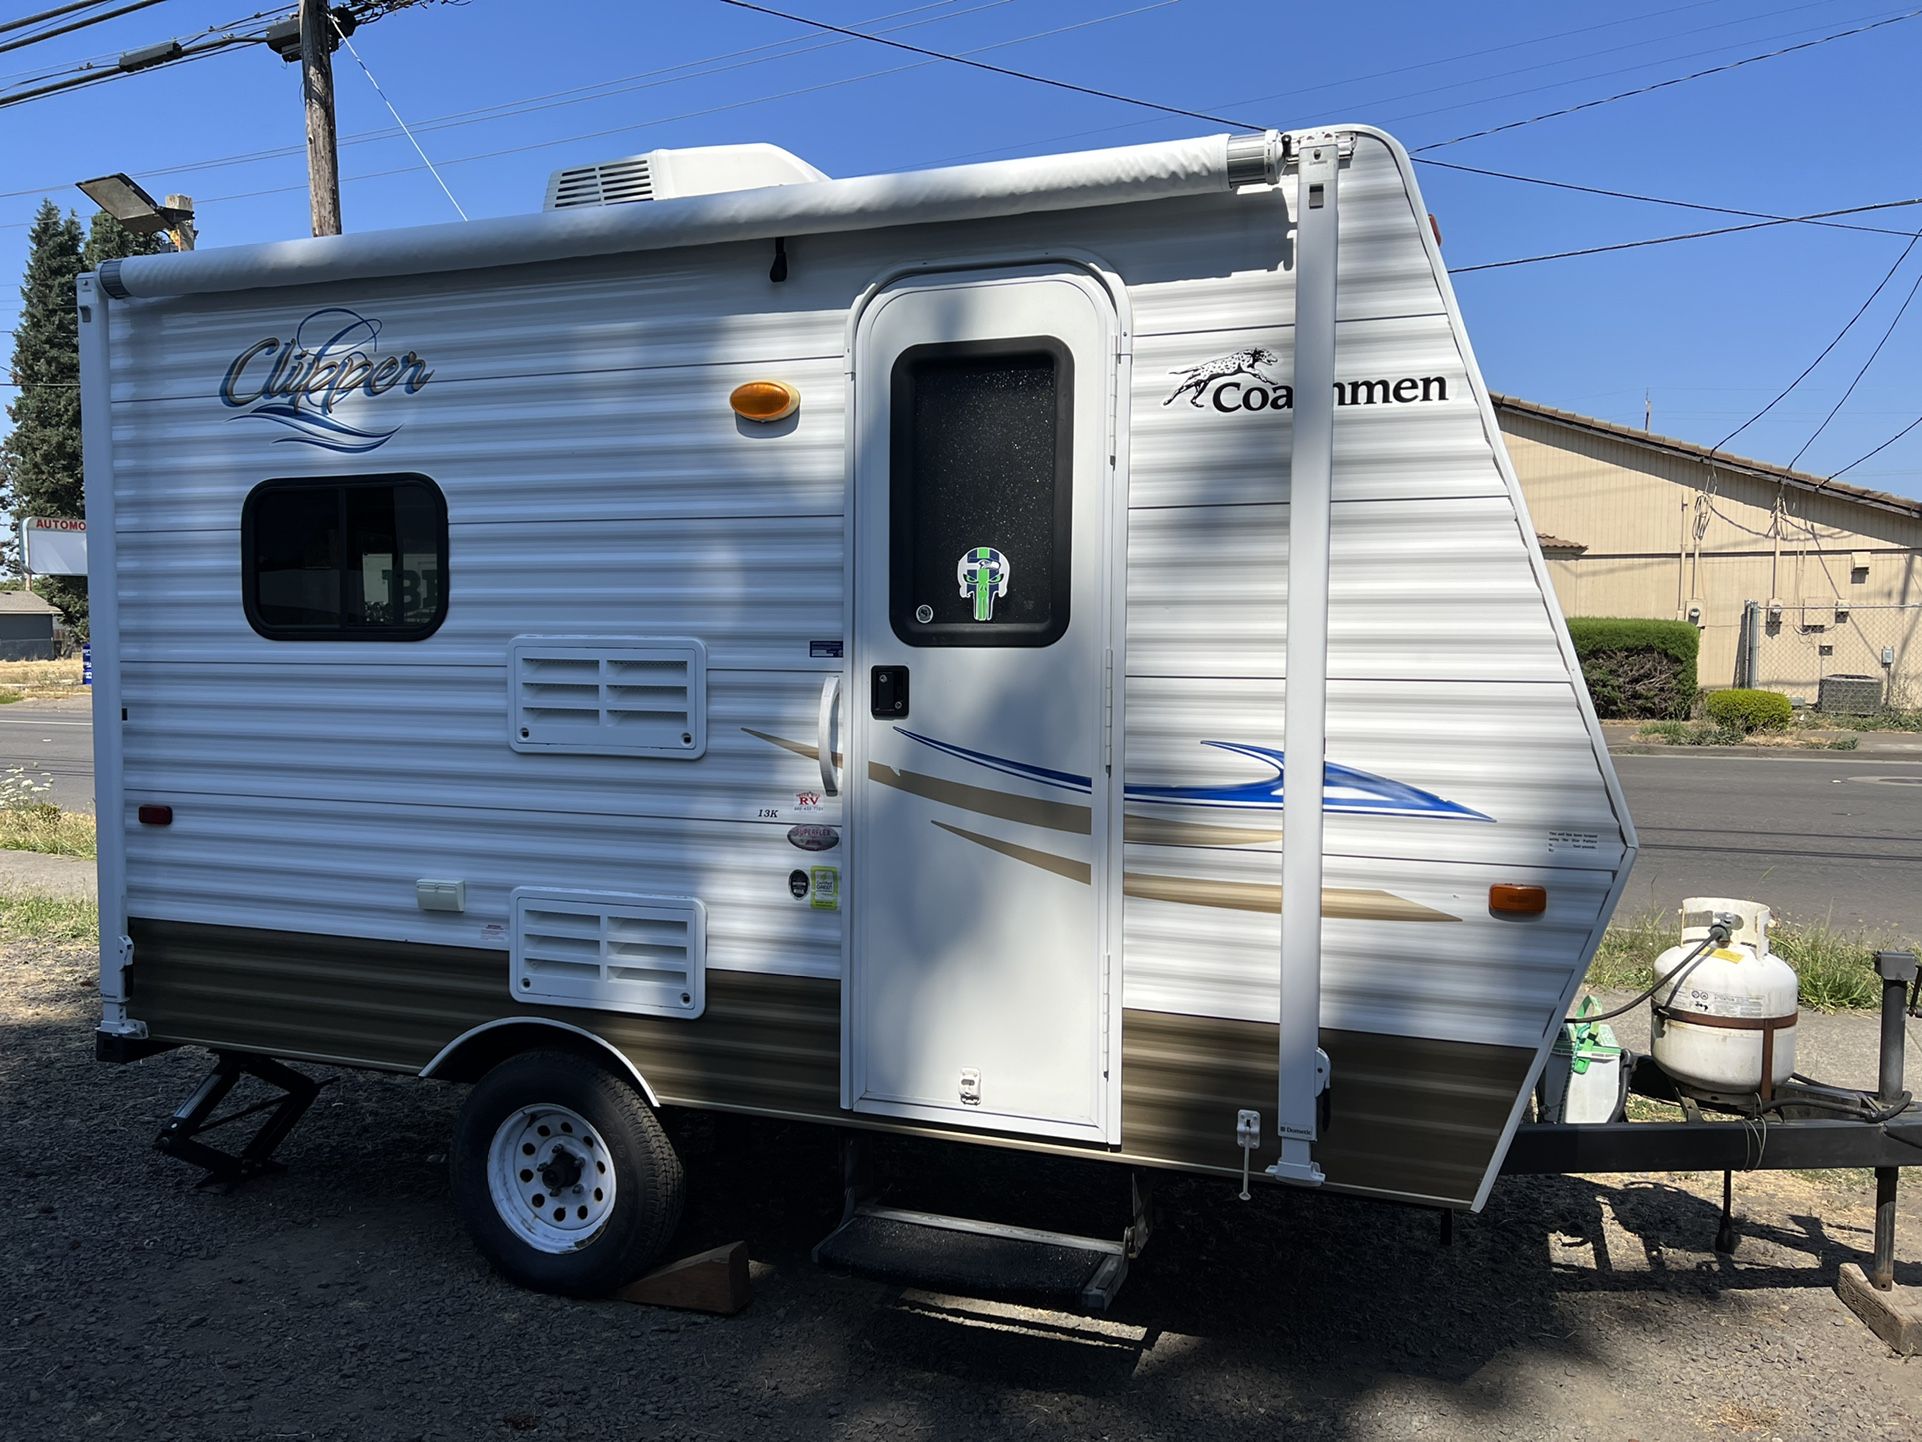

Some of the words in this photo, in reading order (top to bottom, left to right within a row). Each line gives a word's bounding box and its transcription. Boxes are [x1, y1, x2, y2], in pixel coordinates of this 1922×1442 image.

[219, 336, 435, 415] Clipper
[1212, 374, 1449, 414] Coamen
[757, 809, 779, 818] 13K
[799, 797, 819, 806] RV
